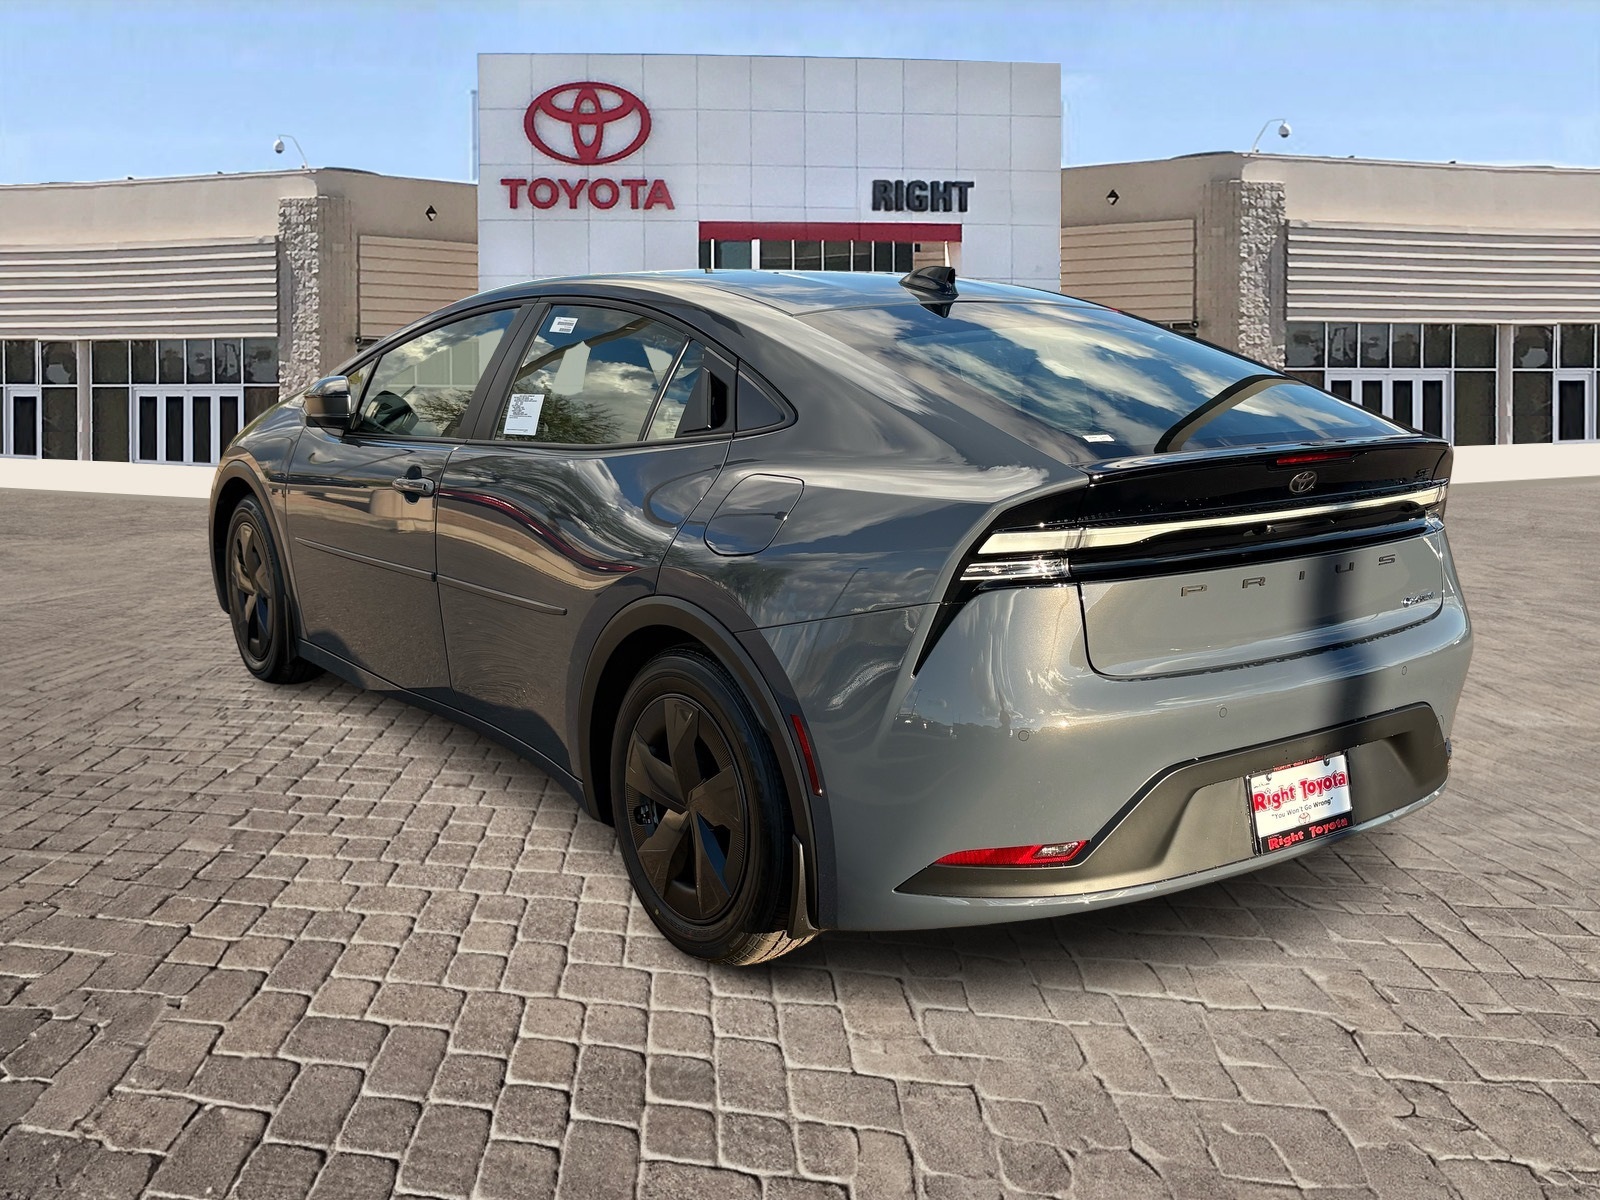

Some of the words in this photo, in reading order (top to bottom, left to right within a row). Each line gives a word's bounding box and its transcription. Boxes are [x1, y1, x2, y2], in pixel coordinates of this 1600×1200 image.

[500, 177, 676, 210] TOYOTA
[872, 179, 975, 212] RIGHT
[1181, 553, 1396, 597] PRIUS
[1253, 784, 1295, 811] Right
[1299, 771, 1347, 799] Toyota
[1287, 805, 1304, 816] Won't
[1268, 830, 1304, 850] Right
[1309, 818, 1348, 838] Toyota
